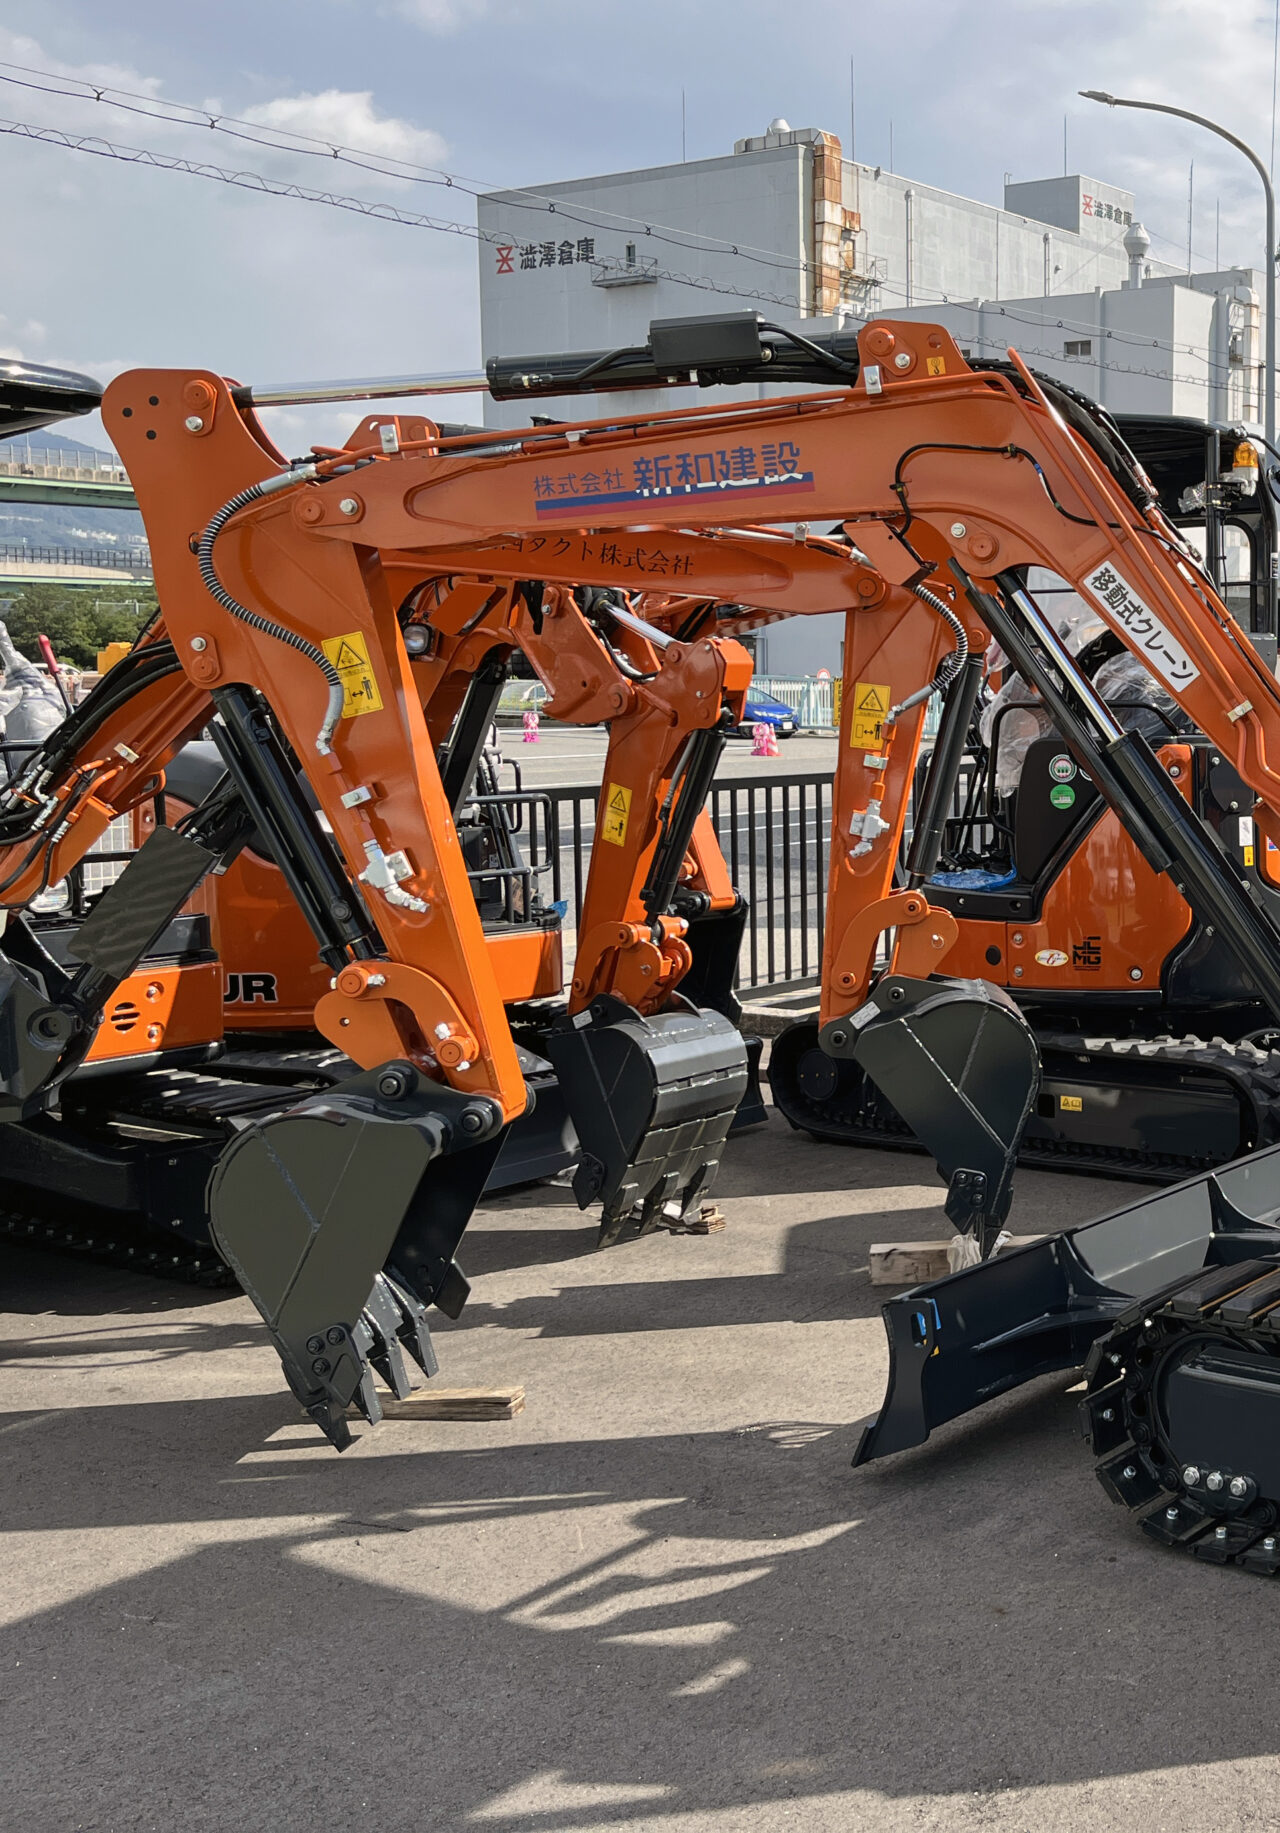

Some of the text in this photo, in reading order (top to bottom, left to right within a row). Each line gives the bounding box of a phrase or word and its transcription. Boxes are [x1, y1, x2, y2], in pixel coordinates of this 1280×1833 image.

[533, 441, 803, 498] 株式会社 新和建設
[1091, 566, 1194, 680] 移動式クレーン
